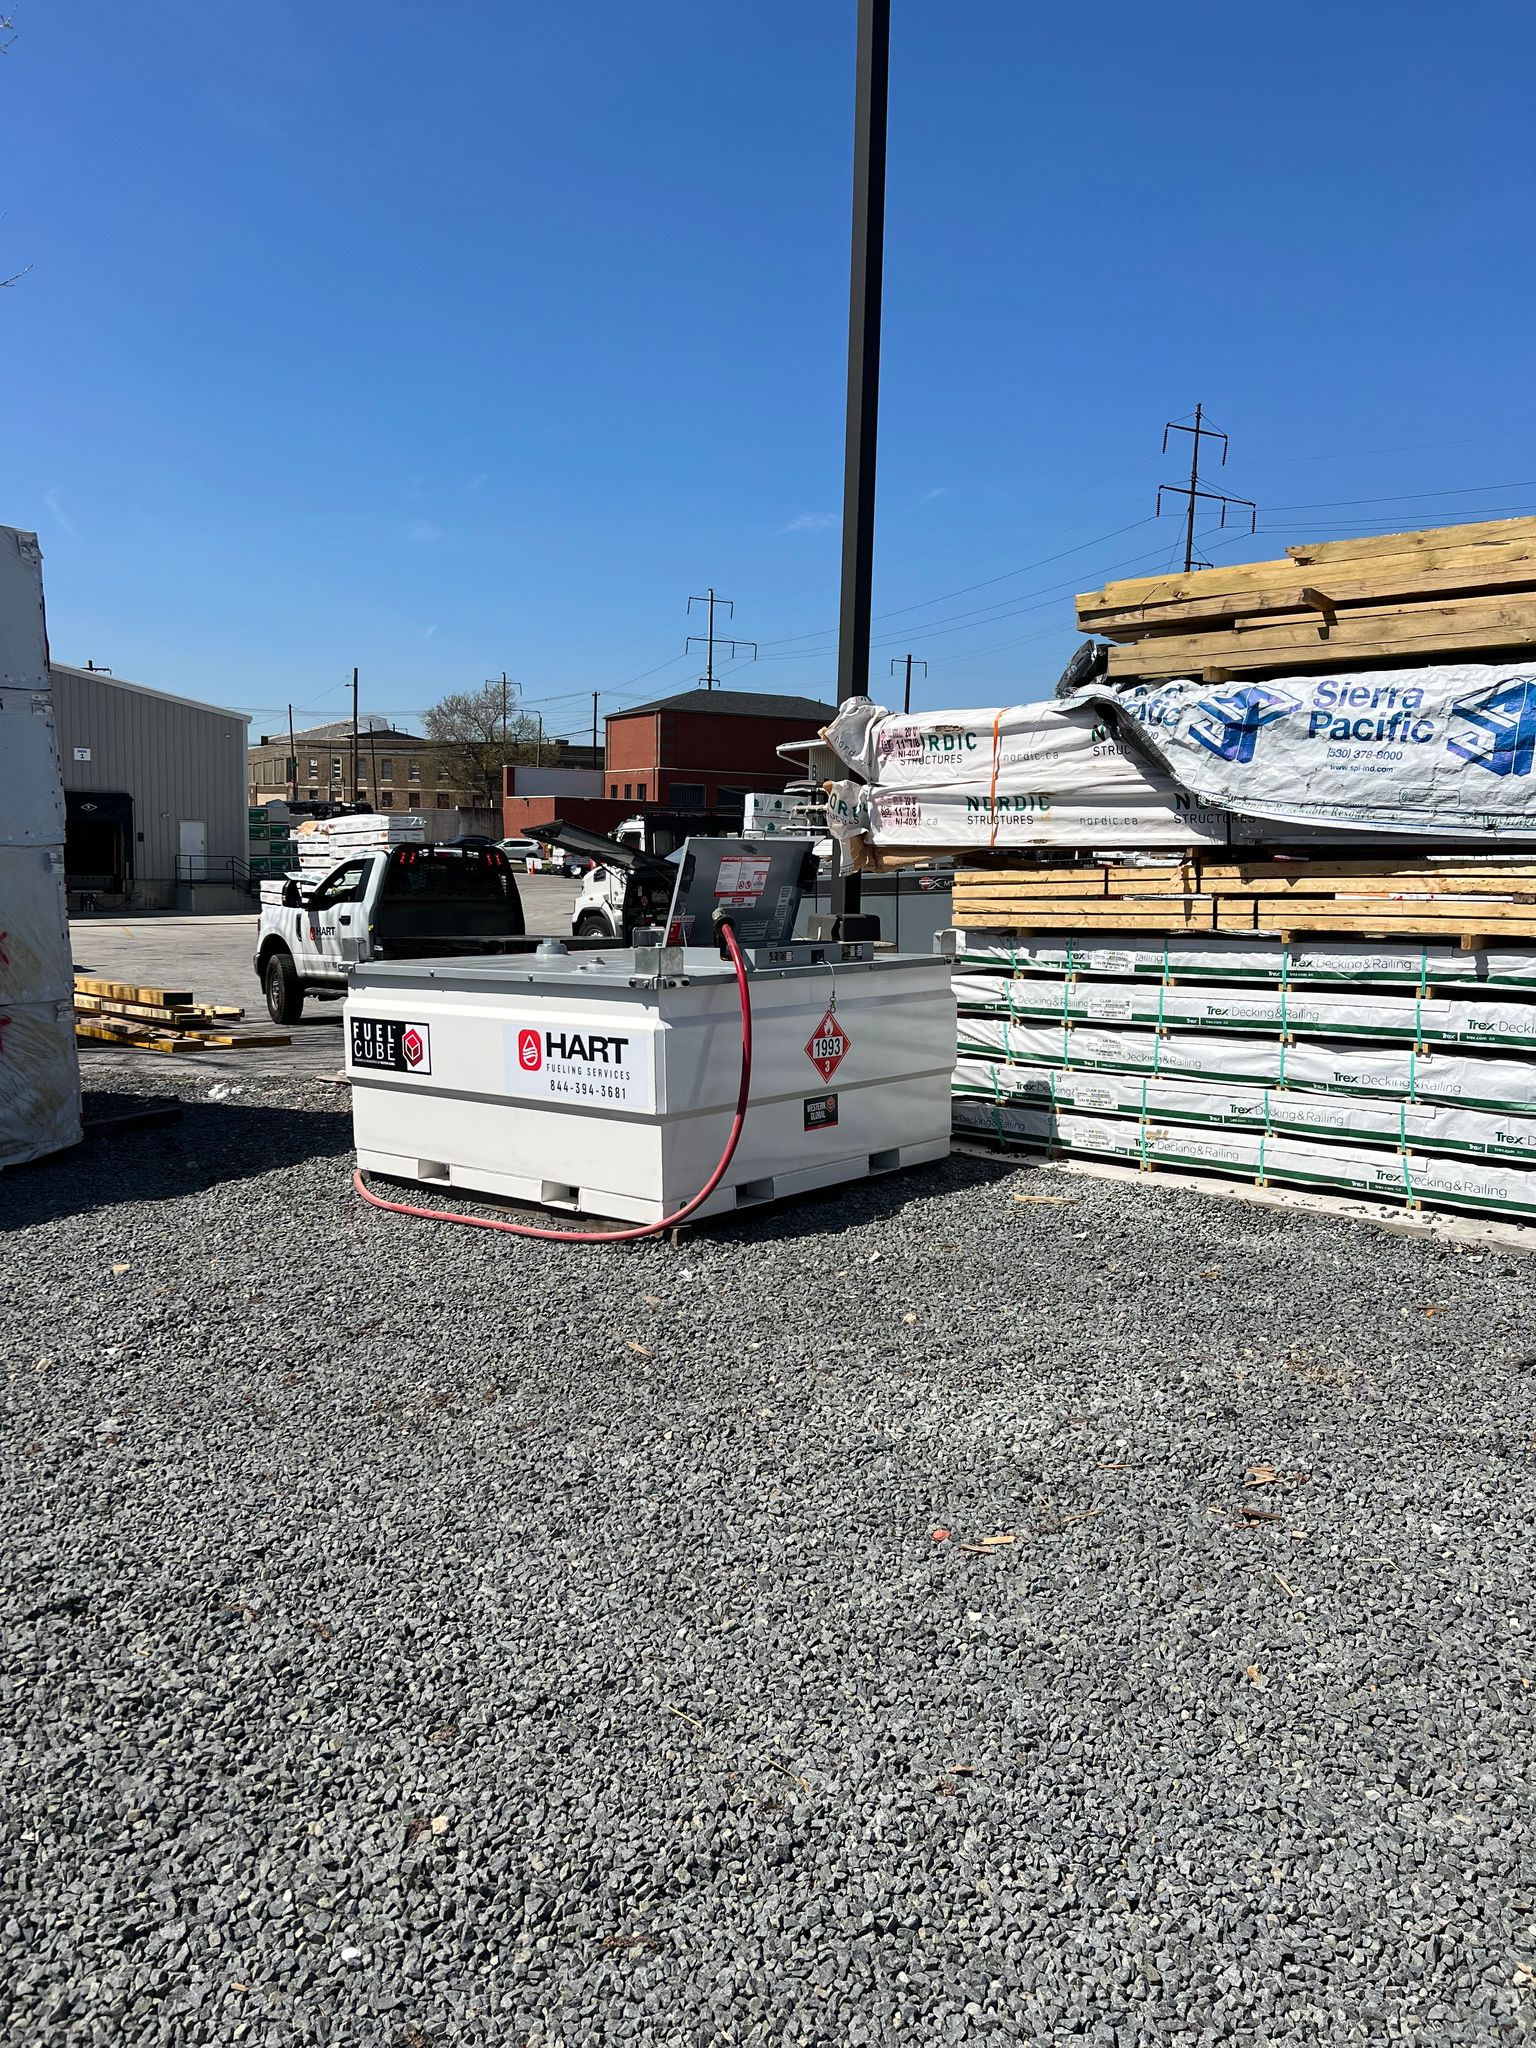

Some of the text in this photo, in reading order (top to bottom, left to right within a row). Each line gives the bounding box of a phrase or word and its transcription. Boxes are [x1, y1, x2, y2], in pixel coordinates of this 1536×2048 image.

[1313, 680, 1425, 709] Sierra
[1308, 711, 1435, 743] Pacific
[1003, 751, 1059, 762] nordic.ca
[1327, 748, 1351, 760] (530)
[967, 796, 1051, 812] NORDIC
[967, 815, 1034, 825] STRUCTURES
[1079, 816, 1139, 826] nordic.ca
[316, 926, 336, 936] HART
[1292, 958, 1314, 969] Trex
[1207, 1005, 1228, 1016] Trex
[1467, 1019, 1495, 1031] Trex
[353, 1021, 395, 1043] FUEL
[354, 1040, 396, 1061] CUBE
[546, 1031, 629, 1065] HART
[816, 1037, 841, 1057] 1993
[546, 1063, 631, 1081] FUELING SERVICES
[824, 1060, 831, 1073] 3
[1333, 1071, 1359, 1084] Trex
[550, 1079, 626, 1100] 844-394-3681
[1016, 1081, 1035, 1091] Trex
[806, 1101, 827, 1113] WESTERN
[1230, 1103, 1252, 1115] Trex
[810, 1110, 827, 1121] GLOBAL
[1495, 1131, 1524, 1145] Trex
[1375, 1170, 1402, 1182] Trex
